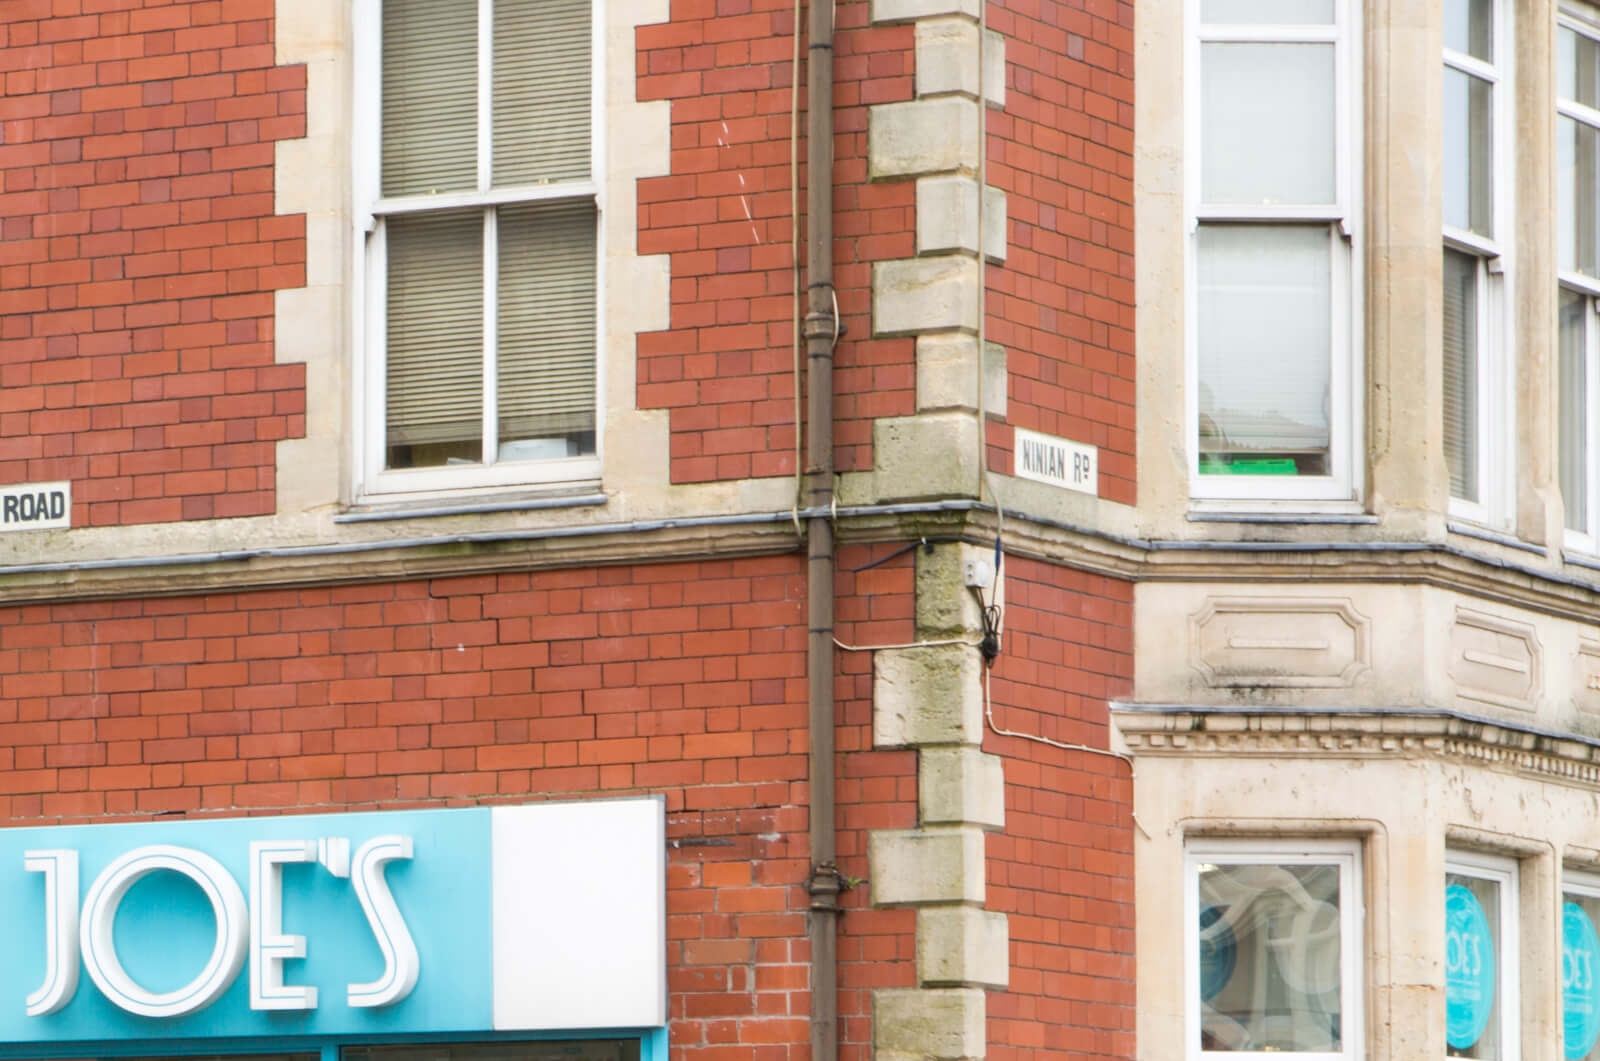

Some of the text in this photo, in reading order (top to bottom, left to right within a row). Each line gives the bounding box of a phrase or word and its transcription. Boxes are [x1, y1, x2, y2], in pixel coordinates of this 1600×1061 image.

[1022, 439, 1065, 480] NINIAN
[3, 491, 65, 523] ROAD
[24, 834, 420, 1018] JOE'S
[1446, 930, 1481, 977] OE'S
[1563, 949, 1593, 991] OE'S
